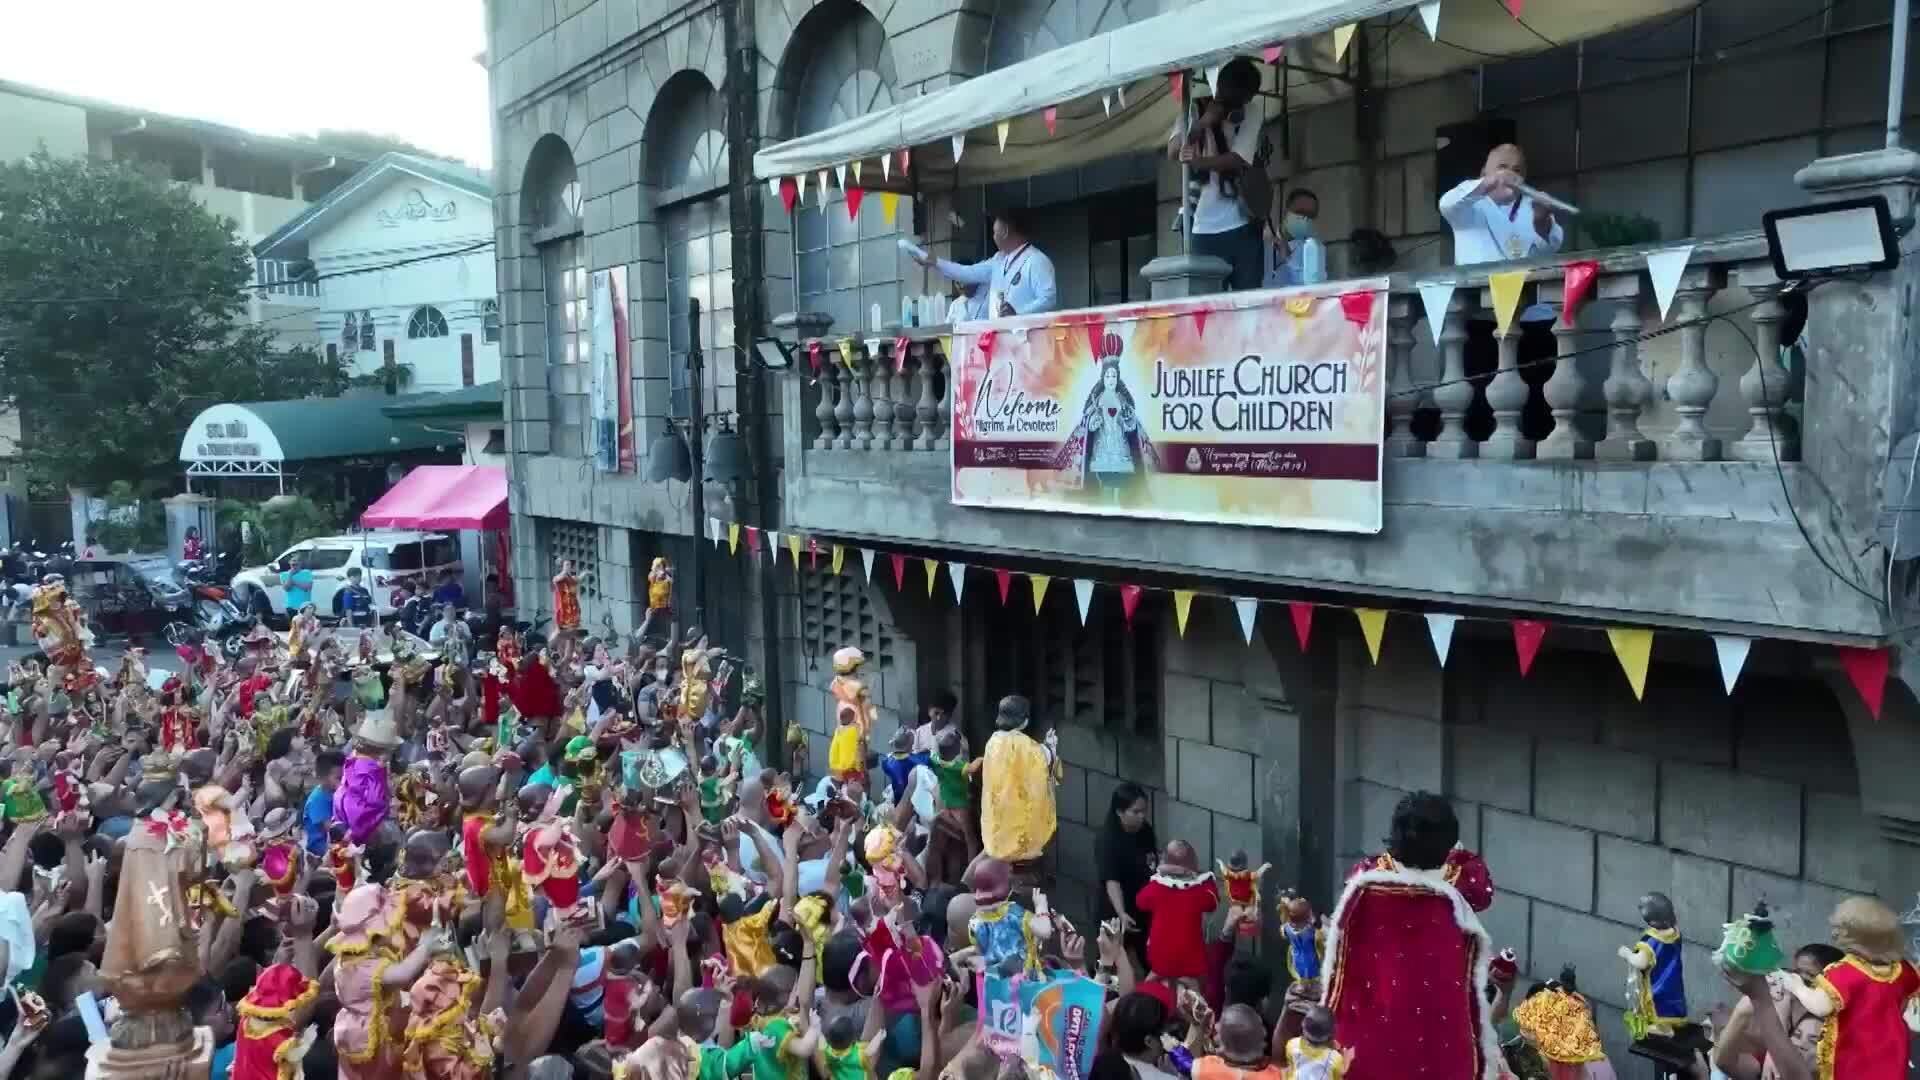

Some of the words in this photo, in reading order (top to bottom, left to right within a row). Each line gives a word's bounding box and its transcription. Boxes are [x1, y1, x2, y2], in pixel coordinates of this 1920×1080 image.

[974, 361, 1062, 424] Welcome
[1151, 360, 1225, 398] JUBILEE
[1234, 355, 1348, 396] CHURCH
[1162, 403, 1204, 431] FOR
[1211, 391, 1333, 432] CHILDREN
